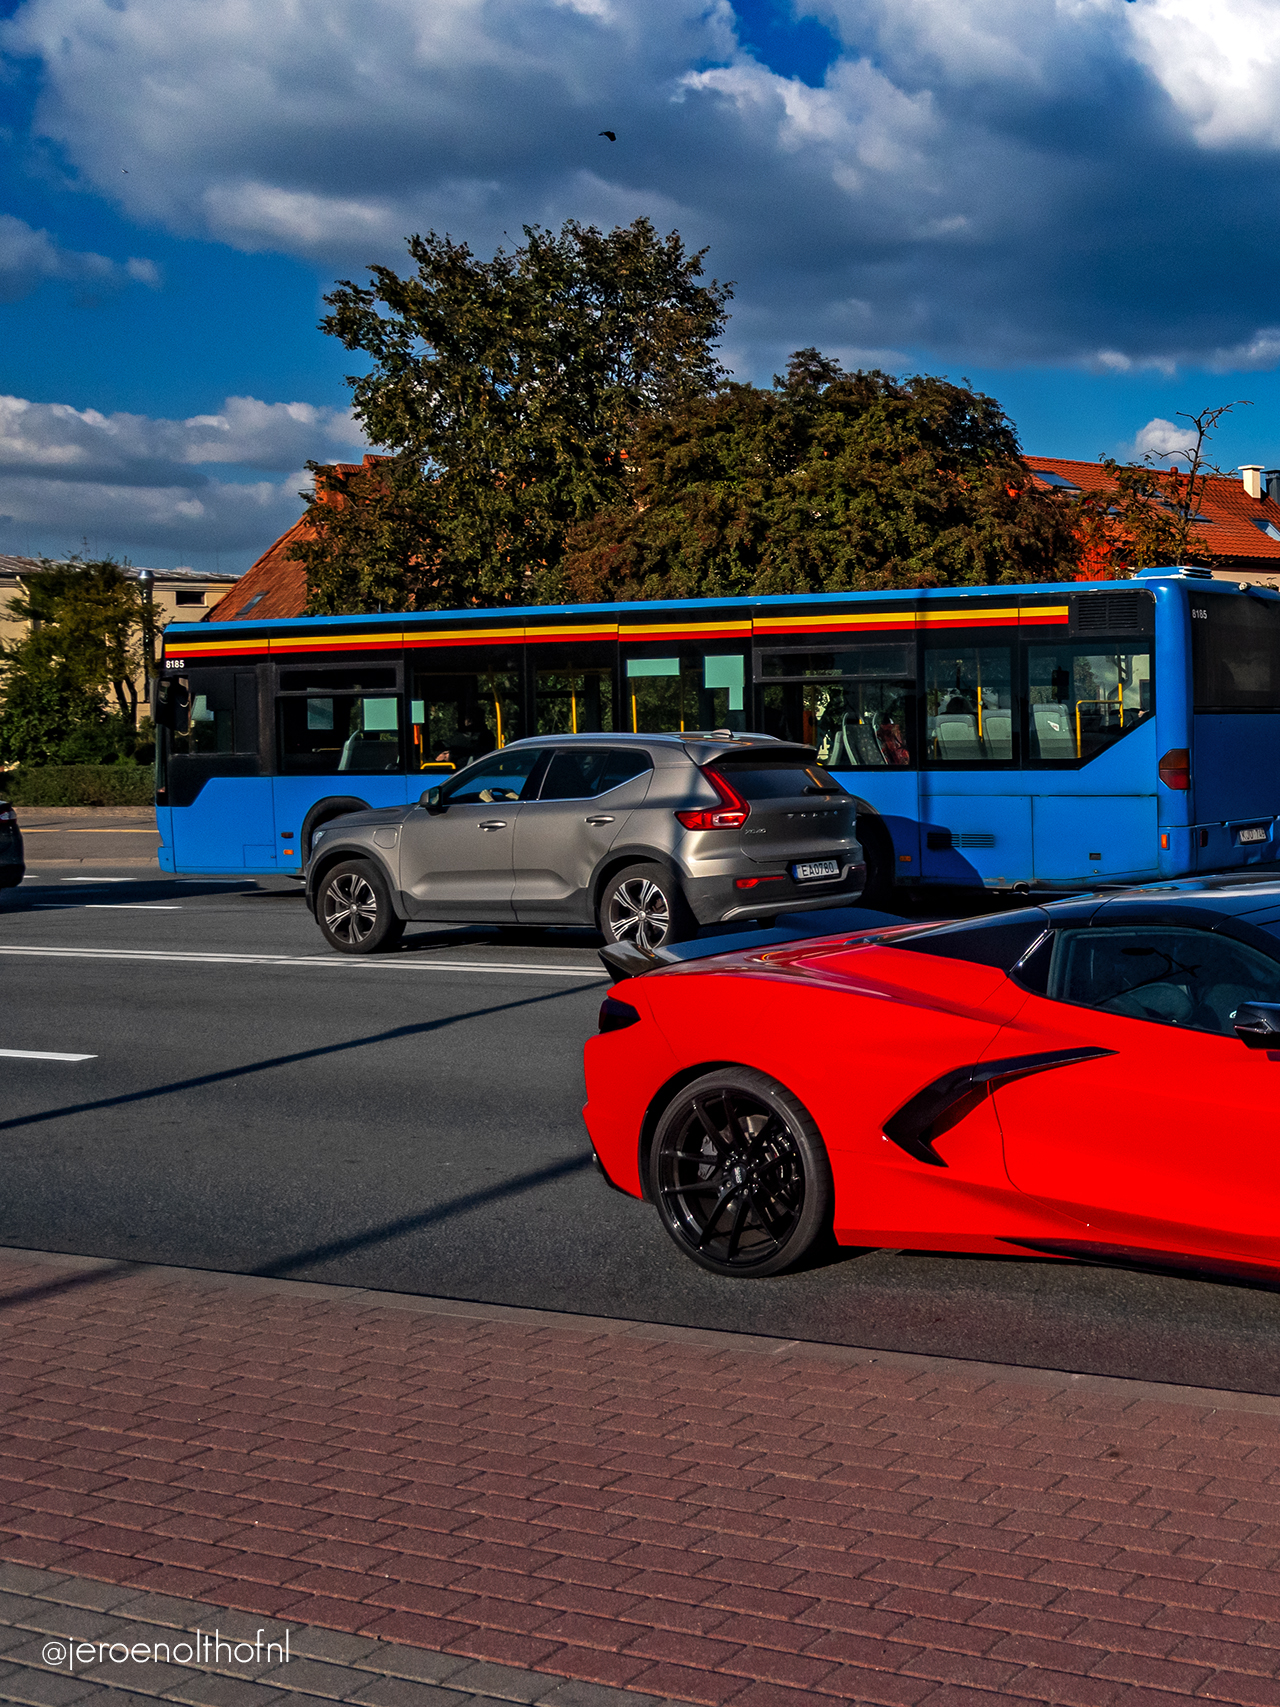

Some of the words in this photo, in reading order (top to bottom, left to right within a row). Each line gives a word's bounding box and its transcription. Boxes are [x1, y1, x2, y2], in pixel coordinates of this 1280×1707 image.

[1191, 609, 1208, 619] 8185
[165, 660, 185, 669] 8185
[801, 862, 835, 877] EA0780
